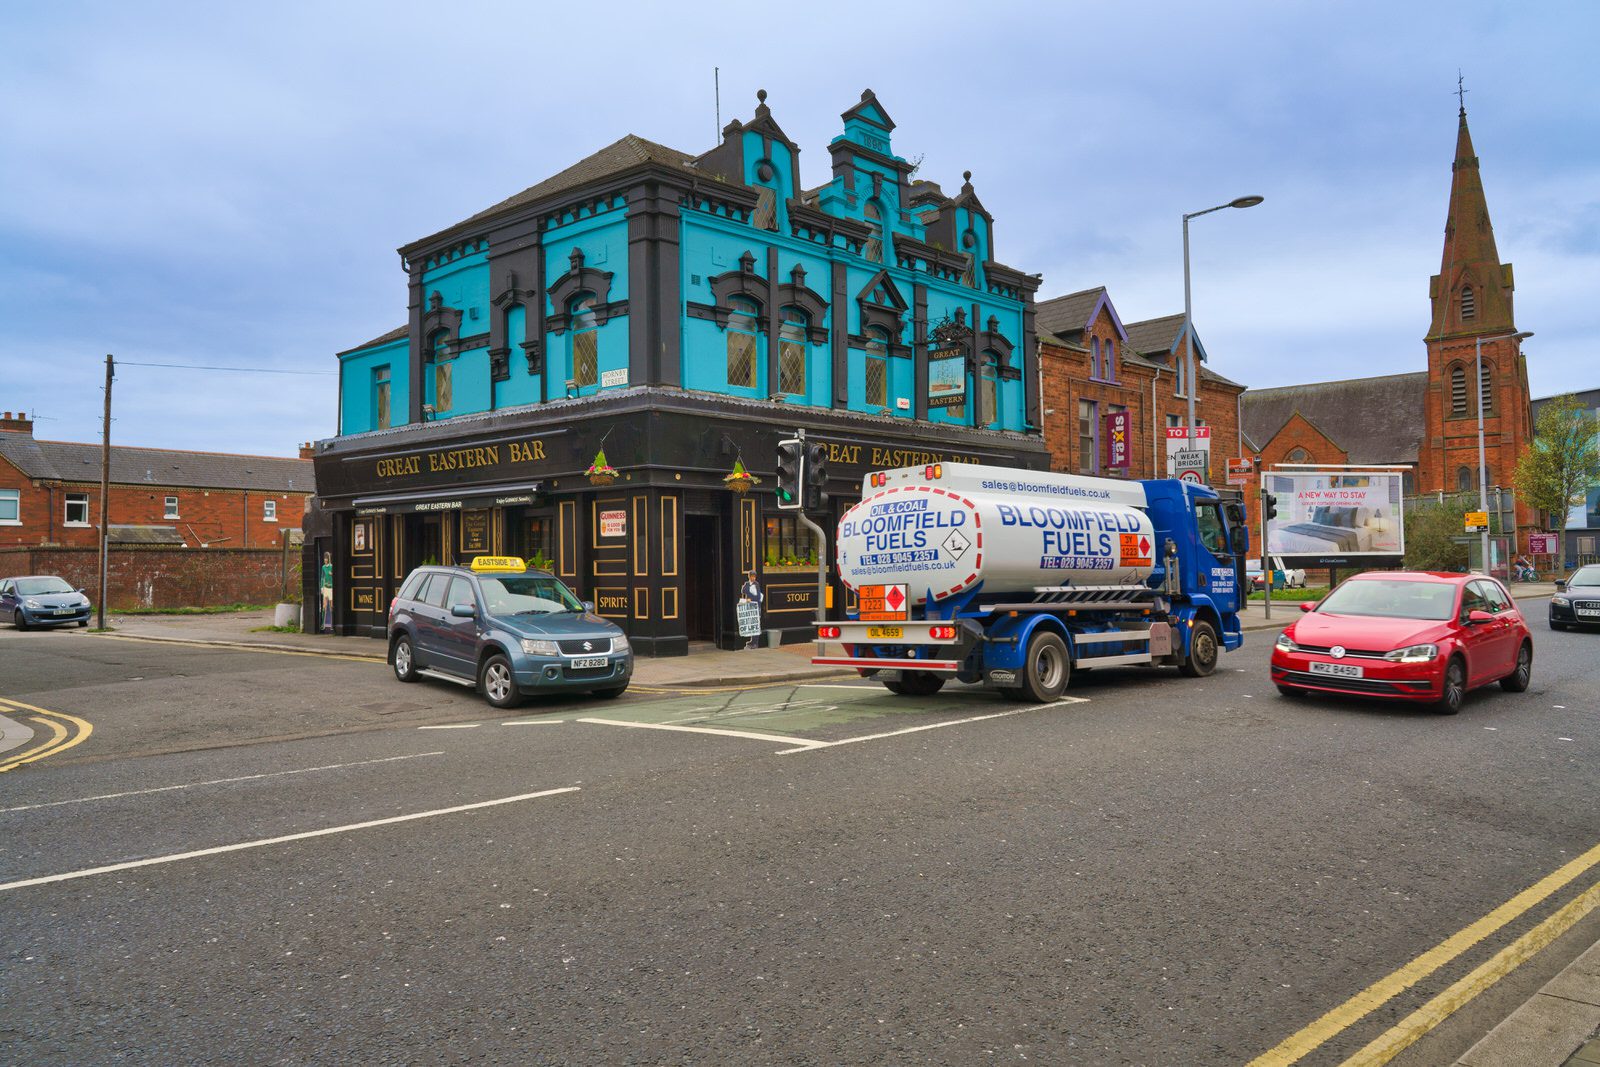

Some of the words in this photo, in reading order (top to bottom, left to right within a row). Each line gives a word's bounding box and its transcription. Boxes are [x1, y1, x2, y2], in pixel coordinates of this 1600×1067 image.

[934, 349, 960, 358] GREAT
[605, 377, 624, 386] STREET
[930, 395, 963, 405] EASTERN
[376, 456, 420, 477] GREAT
[428, 446, 499, 472] EASTERN
[509, 440, 546, 463] BAR
[816, 442, 861, 464] EAT
[872, 447, 942, 467] EASTERN
[982, 480, 1111, 499] sales@bloomfieldfuels.co.uk
[415, 503, 430, 511] GREAT
[431, 502, 451, 510] EASTERN
[871, 504, 887, 515] OIL
[887, 503, 895, 513] &
[896, 500, 927, 513] COAL
[601, 512, 625, 520] GUINNESS
[996, 504, 1141, 533] BLOOMFIELD
[843, 510, 966, 538] BLOOMFIELD
[866, 530, 927, 552] FUELS
[1043, 530, 1112, 556] FUELS
[1124, 535, 1132, 544] 3Y
[1122, 547, 1138, 556] 1223
[478, 558, 508, 566] EASTSIDE
[877, 554, 891, 564] 028
[893, 552, 912, 563] 9045
[915, 550, 935, 561] 2357
[1043, 556, 1060, 568] TEL:
[1060, 557, 1075, 568] 028
[1076, 558, 1094, 569] 9045
[1095, 558, 1112, 569] 2357
[851, 560, 956, 576] sales@bloomfieldfuels.co.uk
[865, 587, 875, 596] 3Y
[358, 594, 373, 603] WINE
[600, 597, 627, 608] SPIRITS
[787, 593, 810, 602] STOUT
[864, 600, 882, 610] 1223
[870, 628, 880, 637] OIL
[882, 628, 899, 637] 4659
[573, 659, 588, 667] NFZ
[589, 658, 606, 666] 8280
[1333, 665, 1358, 675] 8450
